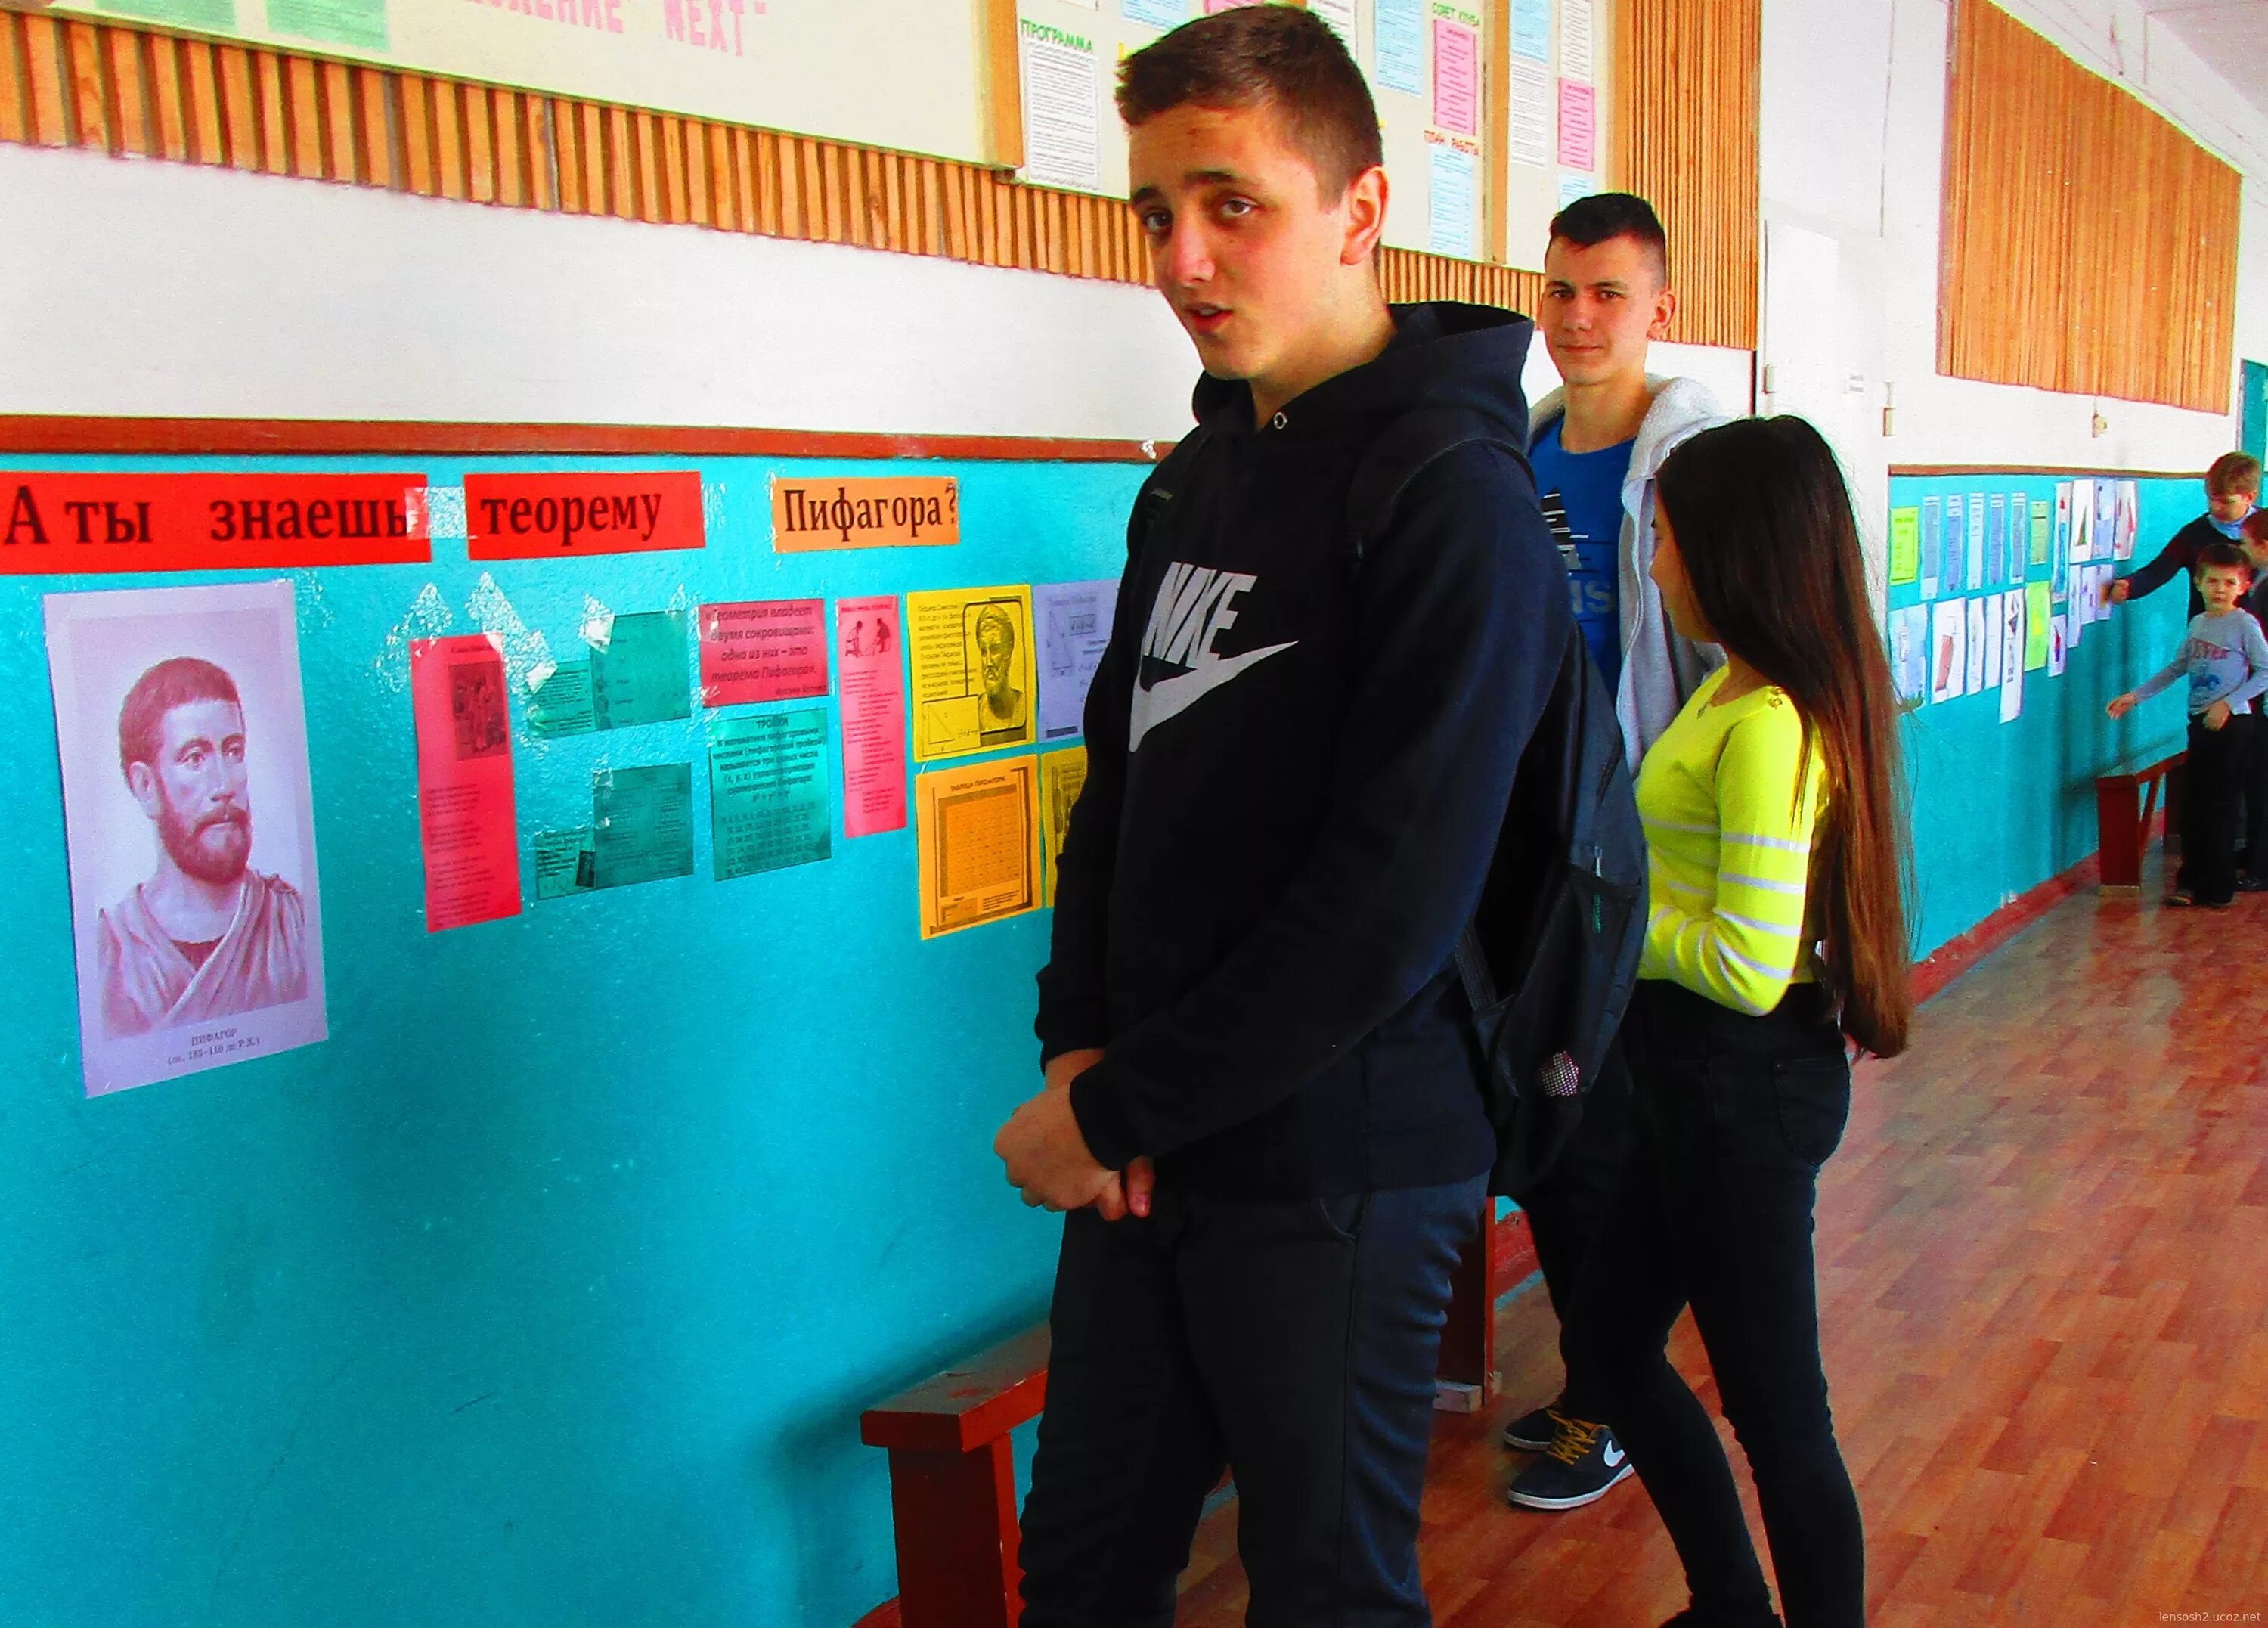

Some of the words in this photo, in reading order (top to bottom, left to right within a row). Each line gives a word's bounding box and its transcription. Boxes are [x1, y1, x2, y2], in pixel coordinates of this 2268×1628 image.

[2, 485, 51, 544] А
[64, 501, 153, 544] ты
[209, 497, 408, 542] знаешь
[480, 492, 663, 546] теорему
[783, 483, 956, 542] Пифагора?
[1142, 561, 1258, 670] NIKE
[748, 650, 760, 659] из
[762, 650, 779, 659] них
[788, 646, 808, 656] это
[191, 1028, 238, 1046] ПИФАГОР
